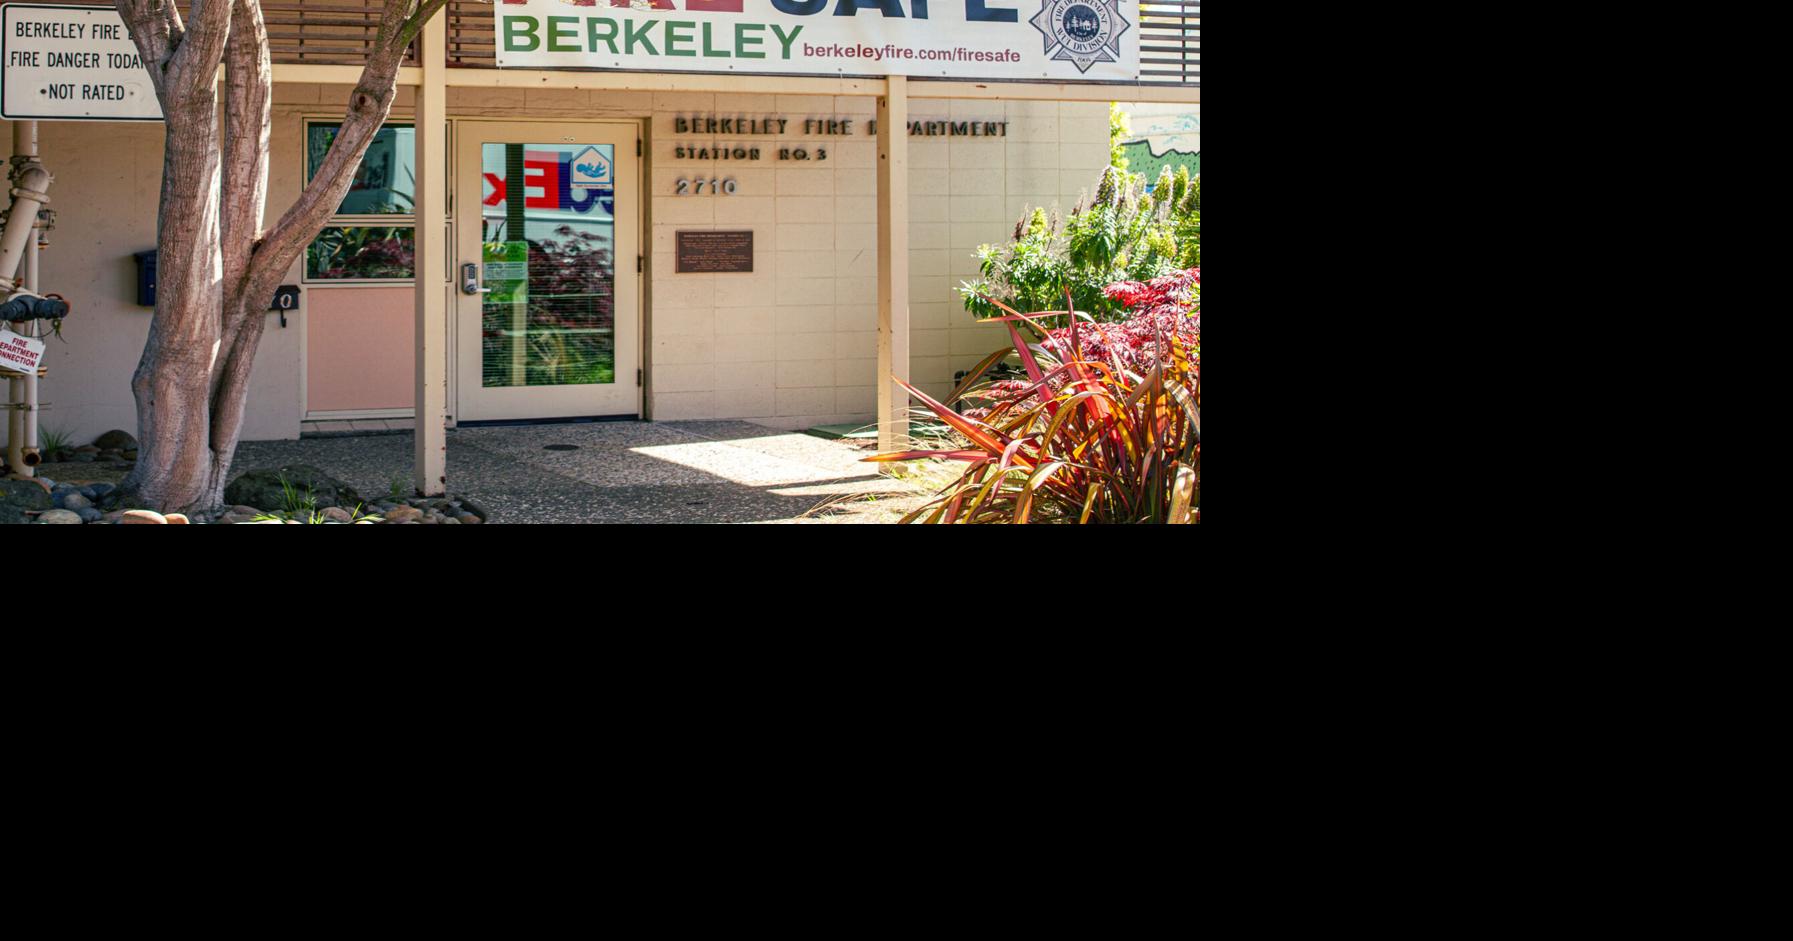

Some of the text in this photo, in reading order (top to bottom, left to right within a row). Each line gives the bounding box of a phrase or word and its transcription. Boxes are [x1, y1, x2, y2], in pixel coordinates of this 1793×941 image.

[16, 22, 85, 39] BERKELEY
[92, 24, 120, 40] FIRE
[503, 15, 803, 60] BERKELEY
[11, 51, 40, 67] FIRE
[47, 52, 100, 68] DANGER
[803, 43, 1021, 63] berkeleyfire.com/firesafe
[49, 84, 125, 101] NOT RATED
[675, 116, 788, 134] BERKELEY
[804, 118, 853, 135] FIRE
[675, 147, 760, 160] STATION
[675, 177, 737, 195] 2710
[0, 341, 39, 360] EPARTMENT
[12, 337, 28, 348] FIRE
[0, 350, 36, 368] ONNECTION
